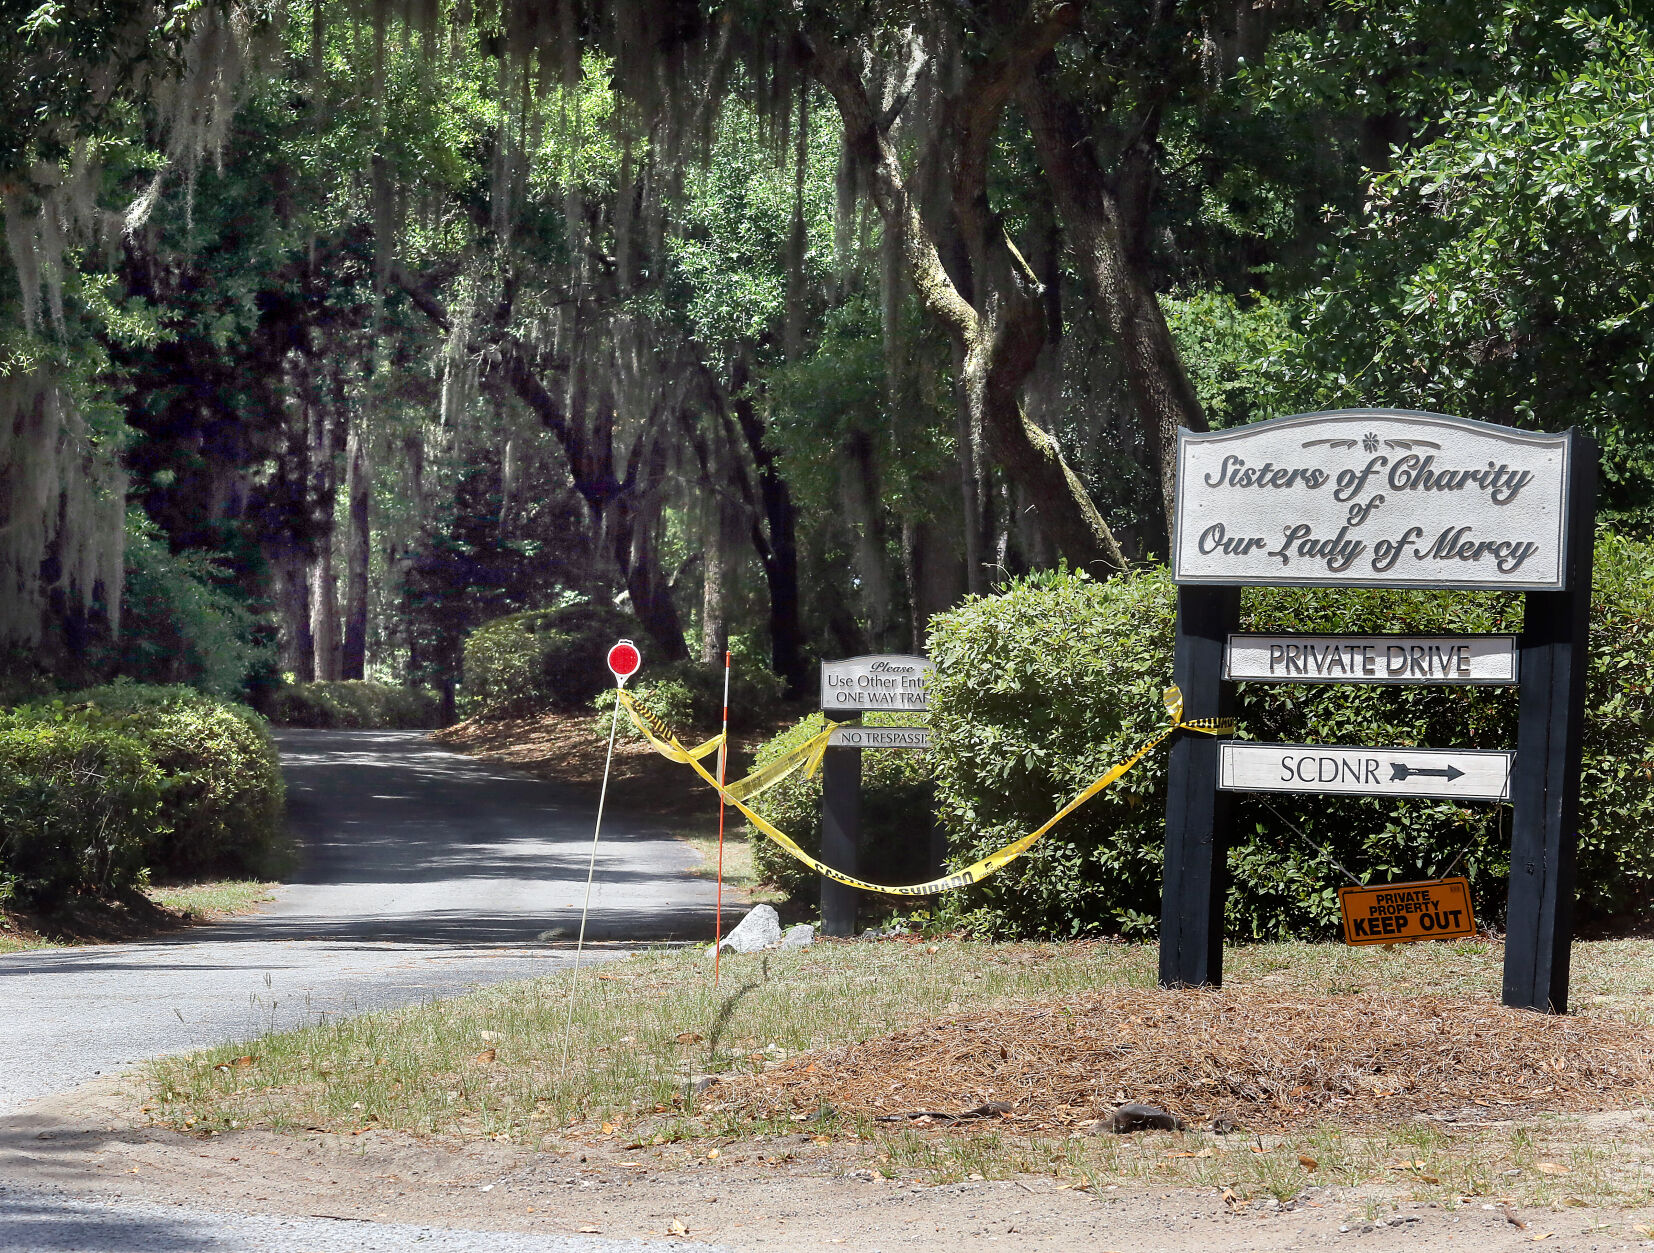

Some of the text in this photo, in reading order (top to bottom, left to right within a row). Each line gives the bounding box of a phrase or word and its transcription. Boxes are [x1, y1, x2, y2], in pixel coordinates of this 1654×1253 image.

[1204, 453, 1535, 506] Sisters of Charity
[1346, 493, 1386, 527] of
[1198, 522, 1539, 575] Our Lady of Mercy
[869, 661, 915, 674] Please
[1269, 644, 1471, 677] PRIVATE DRIVE
[828, 674, 854, 687] Use
[857, 674, 898, 688] Other
[836, 691, 865, 703] ONE
[867, 692, 899, 704] WAY
[841, 732, 862, 744] NO
[1280, 755, 1382, 785] SCDNR
[1368, 900, 1440, 917] PROPERTY
[1375, 890, 1431, 905] PRIVATE
[1353, 910, 1462, 937] KEEP OUT
